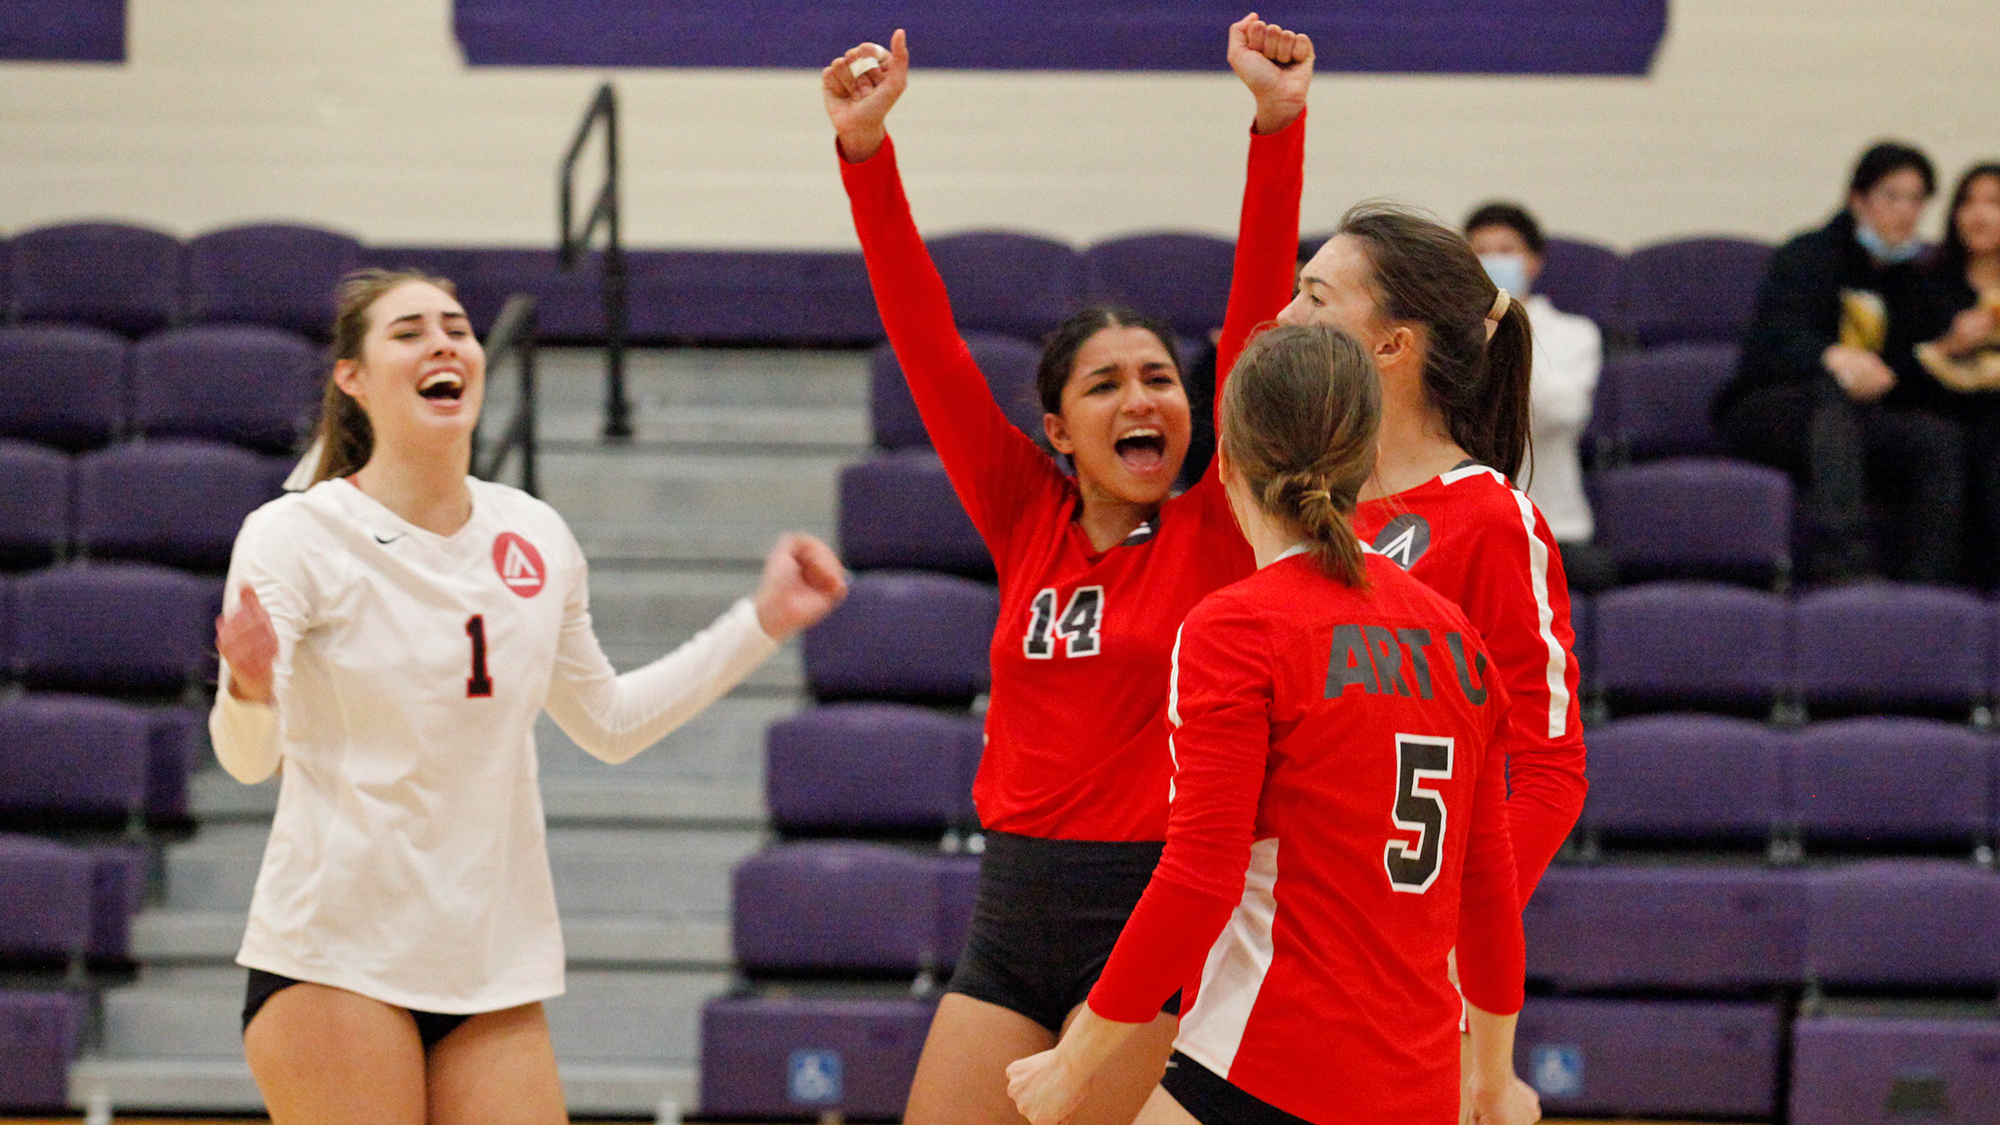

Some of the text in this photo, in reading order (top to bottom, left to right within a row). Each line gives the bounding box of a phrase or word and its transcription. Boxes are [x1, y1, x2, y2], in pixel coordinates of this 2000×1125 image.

[465, 614, 493, 698] 1
[1024, 586, 1105, 659] 14
[1325, 624, 1488, 706] ART U
[1384, 733, 1454, 894] 5
